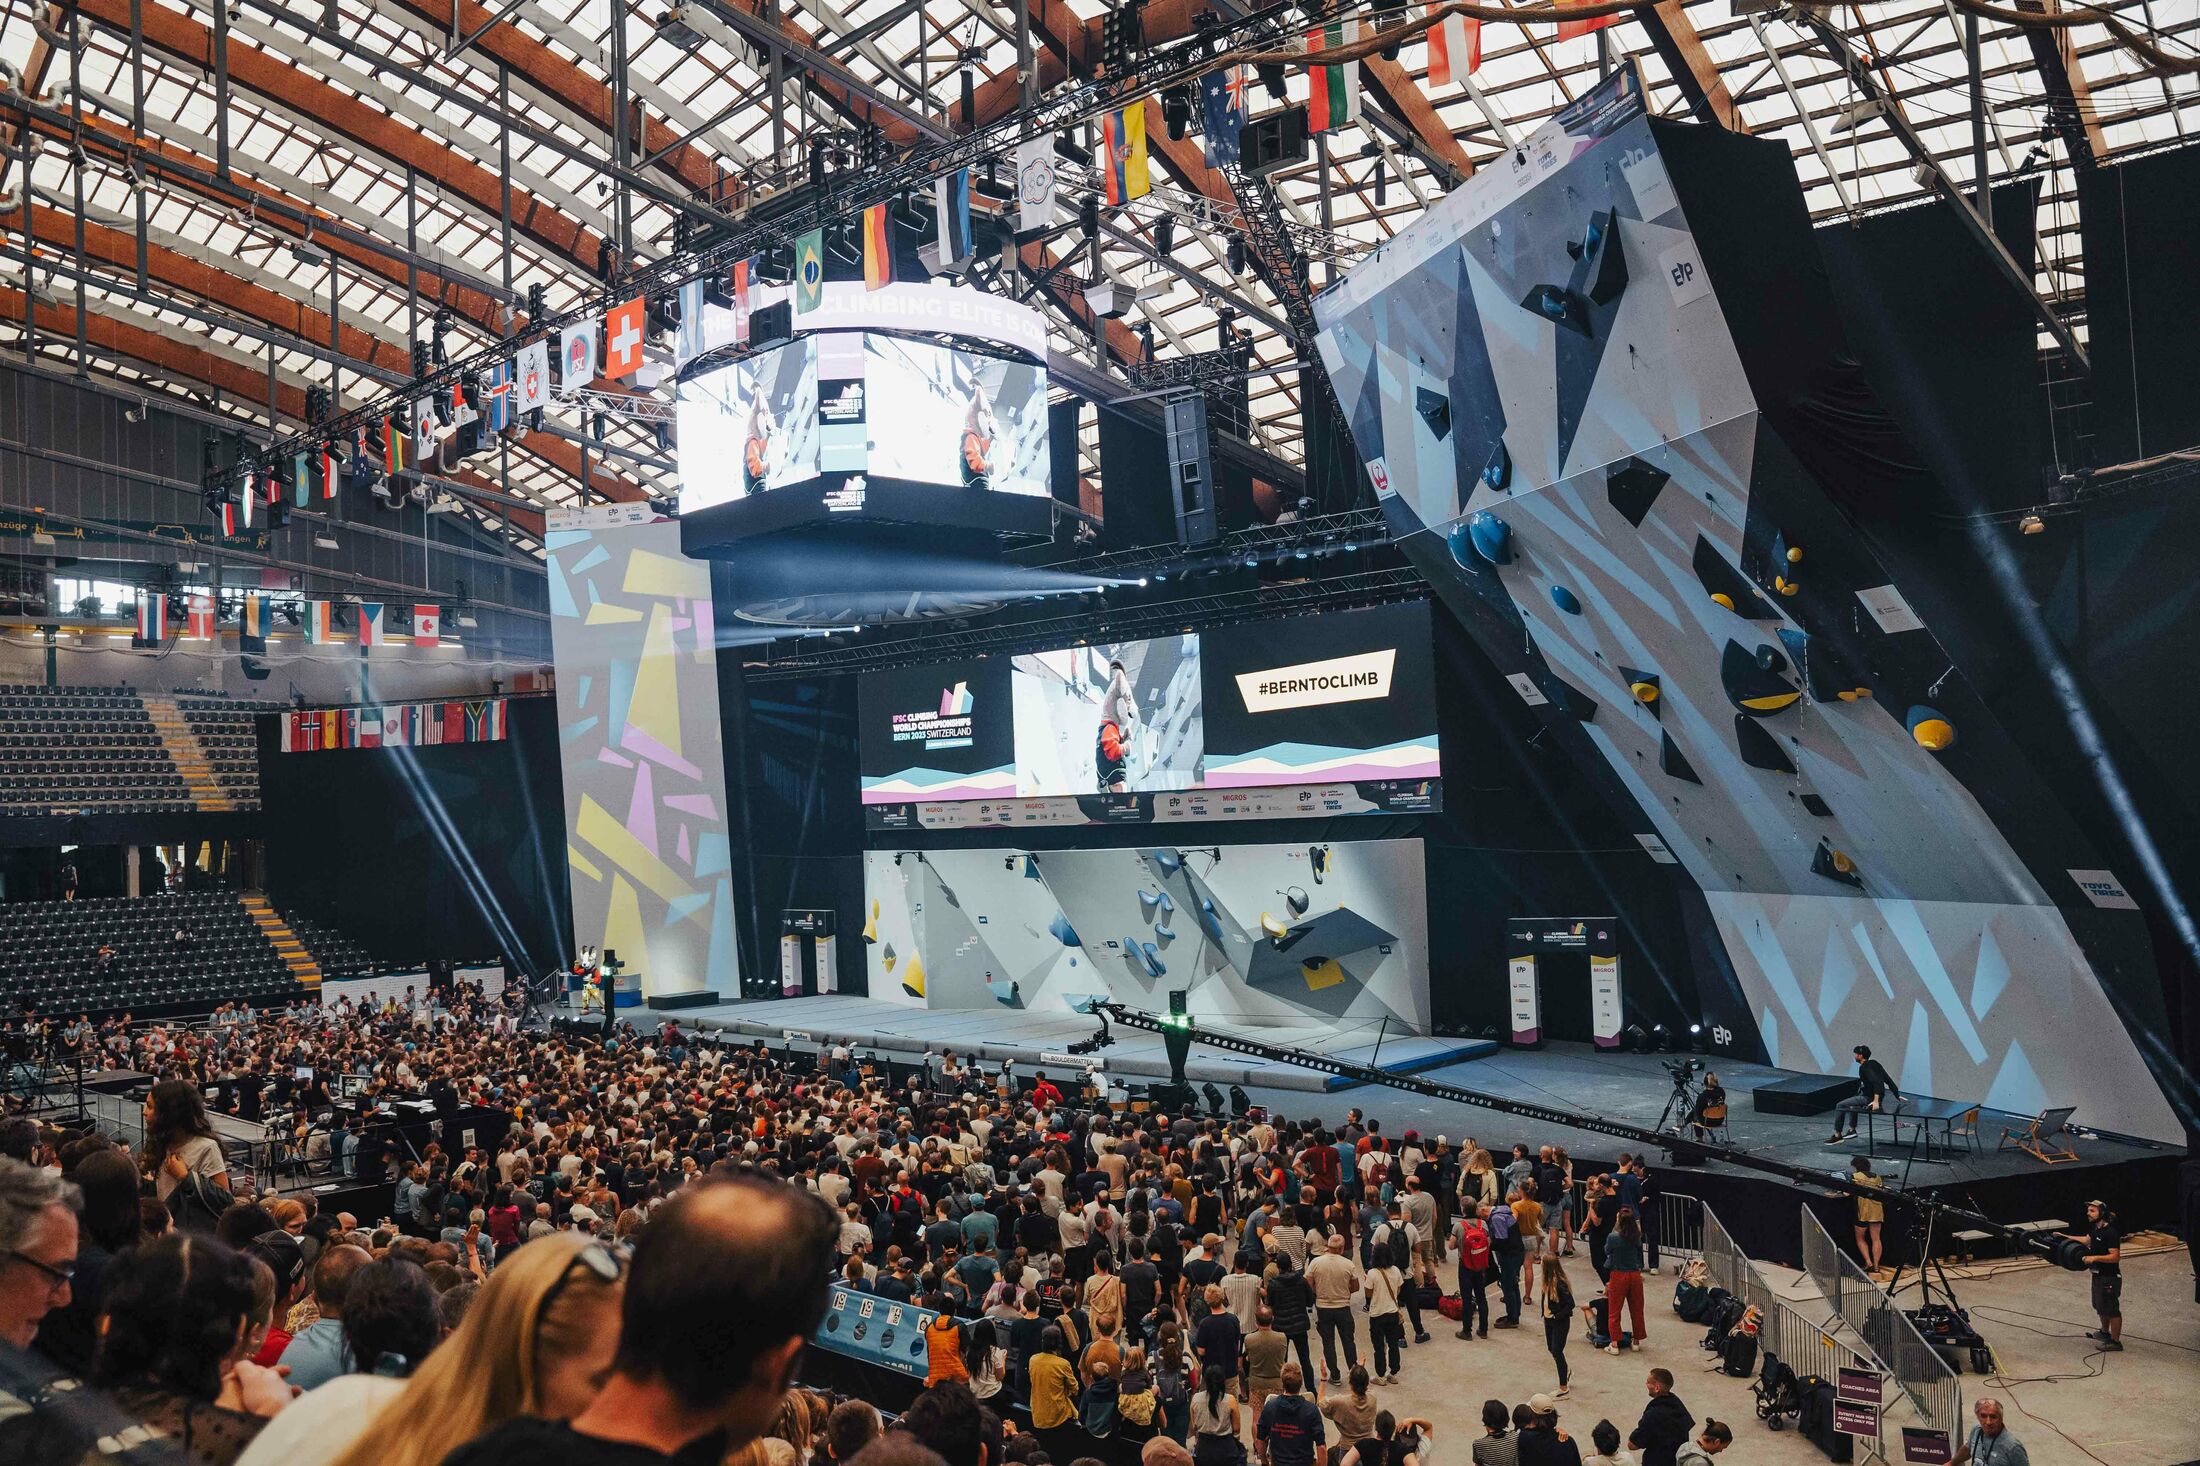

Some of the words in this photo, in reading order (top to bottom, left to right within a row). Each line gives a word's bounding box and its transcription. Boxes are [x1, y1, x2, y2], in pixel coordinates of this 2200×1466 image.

[822, 295, 944, 317] CLIMBING
[948, 299, 1002, 329] ELITE
[1005, 311, 1020, 330] IS
[1258, 671, 1379, 696] #BERNTOCLIMB
[892, 714, 907, 723] IFSC
[907, 711, 938, 722] CLIMBING
[893, 722, 917, 732] WORLD
[917, 717, 972, 730] CHAMPIONSHIPS
[893, 732, 911, 741] BERN
[910, 731, 926, 740] 2023
[926, 727, 972, 739] SWITZERLAND
[1222, 794, 1247, 802] MIGROS
[2080, 882, 2112, 890] TOYO
[2090, 889, 2125, 897] TIRES
[1840, 1383, 1865, 1392] COACHES
[1865, 1387, 1880, 1395] AREA
[1838, 1410, 1855, 1418] ZUTRITT
[1929, 1448, 1945, 1456] AREA
